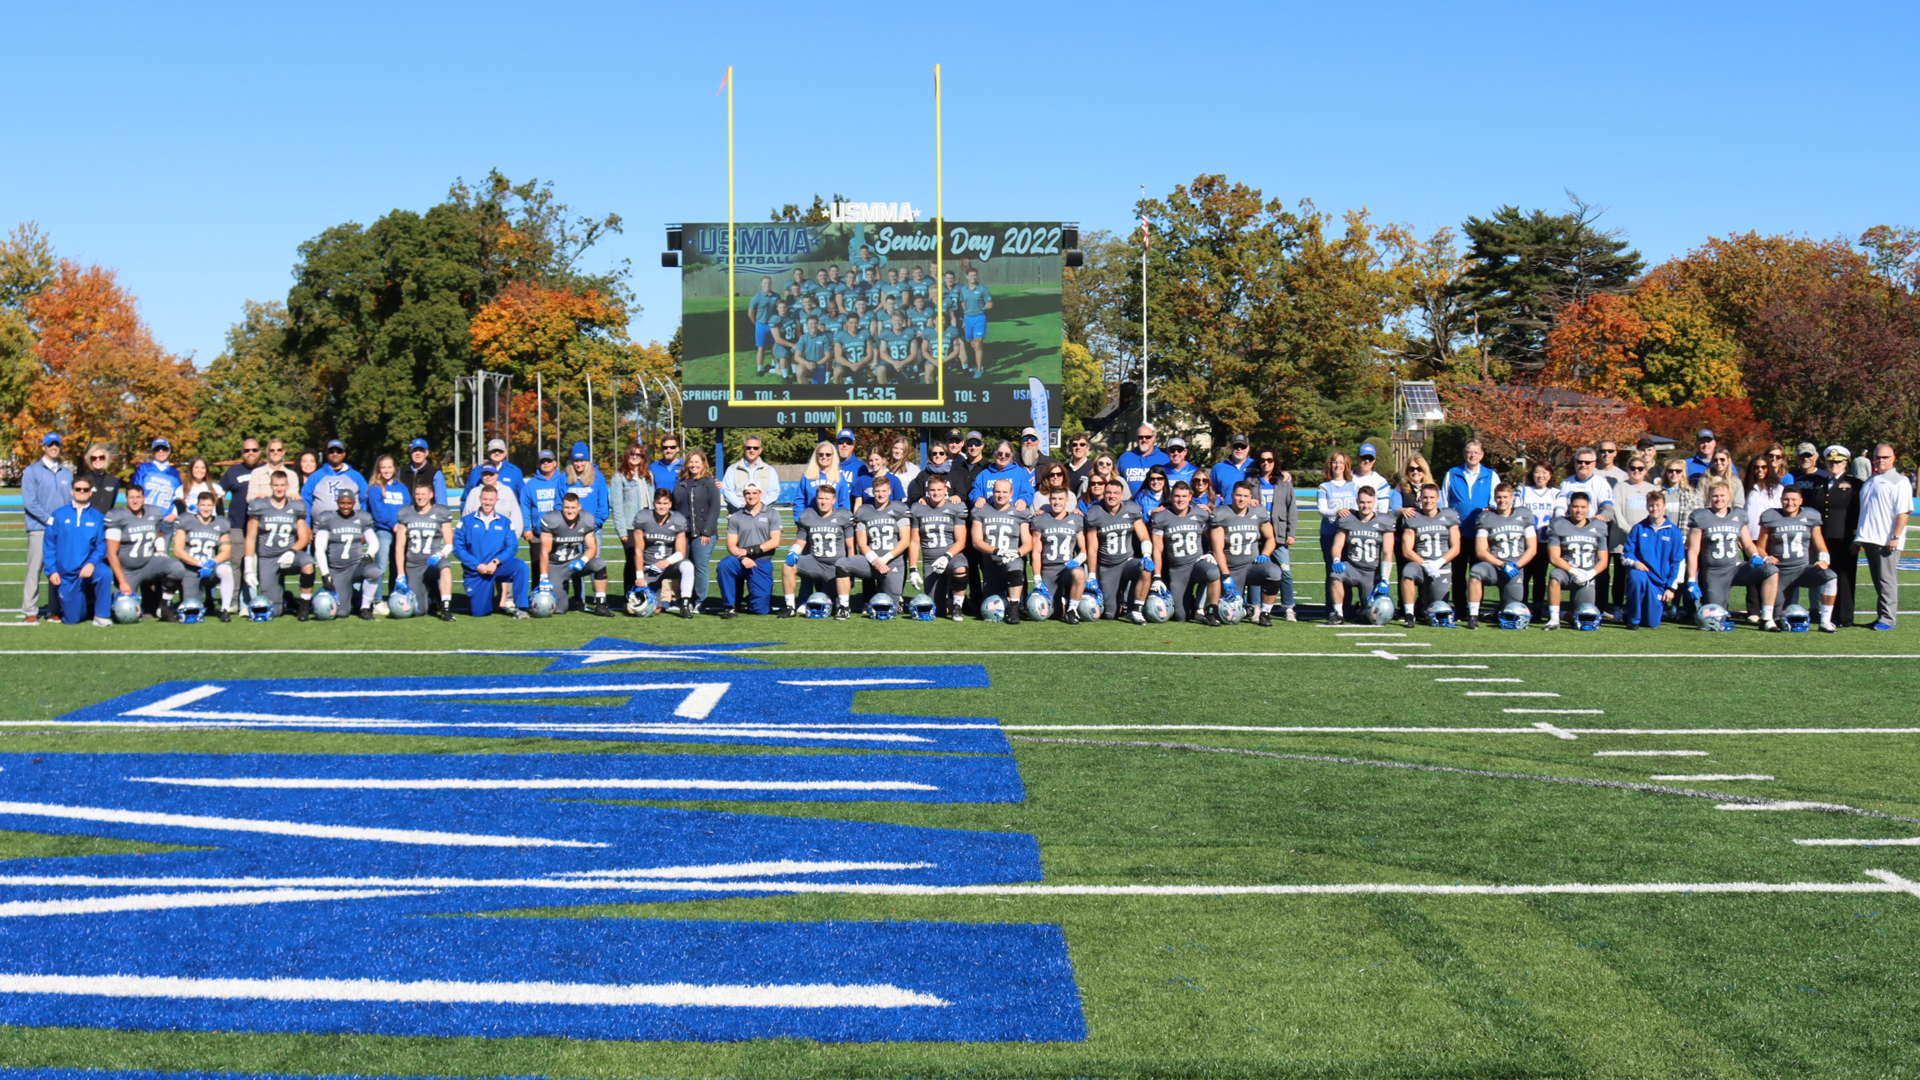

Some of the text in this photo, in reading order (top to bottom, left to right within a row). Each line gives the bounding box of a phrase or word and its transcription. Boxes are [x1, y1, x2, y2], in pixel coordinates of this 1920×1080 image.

[831, 202, 914, 223] USMMA
[698, 227, 812, 255] USMMA
[950, 227, 995, 262] Day
[1001, 227, 1062, 255] 2022
[890, 345, 907, 359] 83
[682, 390, 743, 401] SPRINGFIED
[846, 387, 897, 401] 15:35
[954, 390, 990, 402] TOL: 3
[708, 405, 718, 422] 0
[776, 411, 788, 424] Q:
[790, 411, 797, 424] 1
[844, 411, 851, 424] 1
[862, 411, 895, 424] TOGO:
[898, 411, 913, 424] 10
[921, 411, 950, 424] BALL:
[952, 411, 968, 424] 35
[144, 482, 174, 509] 72
[129, 532, 156, 559] 72
[265, 523, 293, 548] 79
[340, 534, 354, 560] 7
[811, 533, 837, 558] 83
[924, 524, 948, 549] 51
[985, 524, 1013, 552] 56
[1046, 535, 1072, 561] 34
[1171, 531, 1198, 558] 28
[1229, 532, 1258, 556] 97
[1419, 532, 1443, 557] 31
[1494, 532, 1522, 559] 37
[1710, 533, 1738, 559] 33
[1780, 532, 1805, 559] 14
[653, 541, 666, 560] 3
[1350, 537, 1377, 563] 30
[1567, 542, 1594, 568] 32
